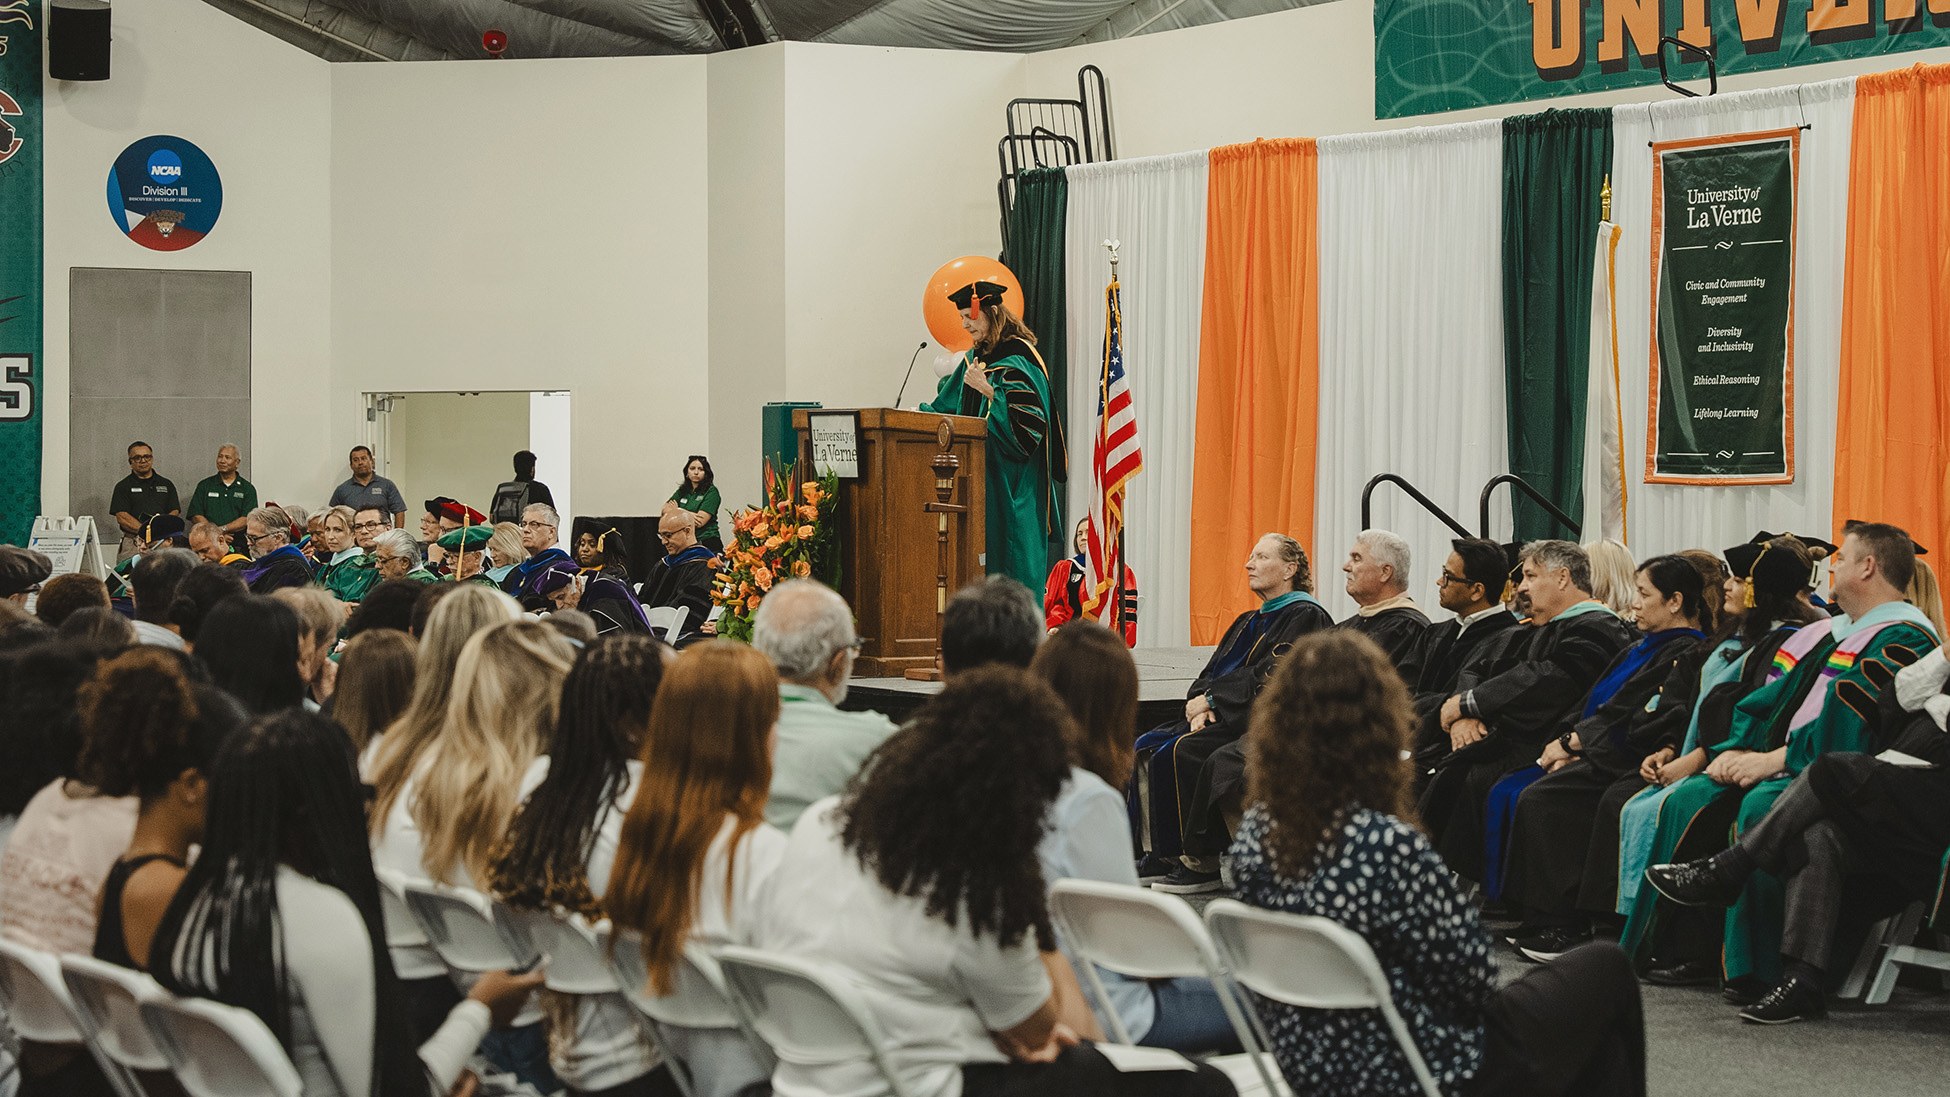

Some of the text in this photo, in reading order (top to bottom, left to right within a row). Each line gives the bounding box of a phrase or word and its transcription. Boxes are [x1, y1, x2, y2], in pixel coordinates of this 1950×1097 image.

[151, 165, 181, 176] NCAA
[142, 186, 188, 196] Division III
[1687, 185, 1761, 204] University of
[1687, 204, 1762, 229] La Verne
[1686, 277, 1766, 291] Civic and Community
[1701, 294, 1747, 306] Engagement
[1707, 326, 1742, 338] Diversity
[1698, 341, 1754, 352] and Inclusivity
[1693, 374, 1760, 386] Ethical Reasoning
[1694, 407, 1759, 420] Lifelong Learning
[813, 429, 850, 444] University
[814, 444, 858, 462] La Verne
